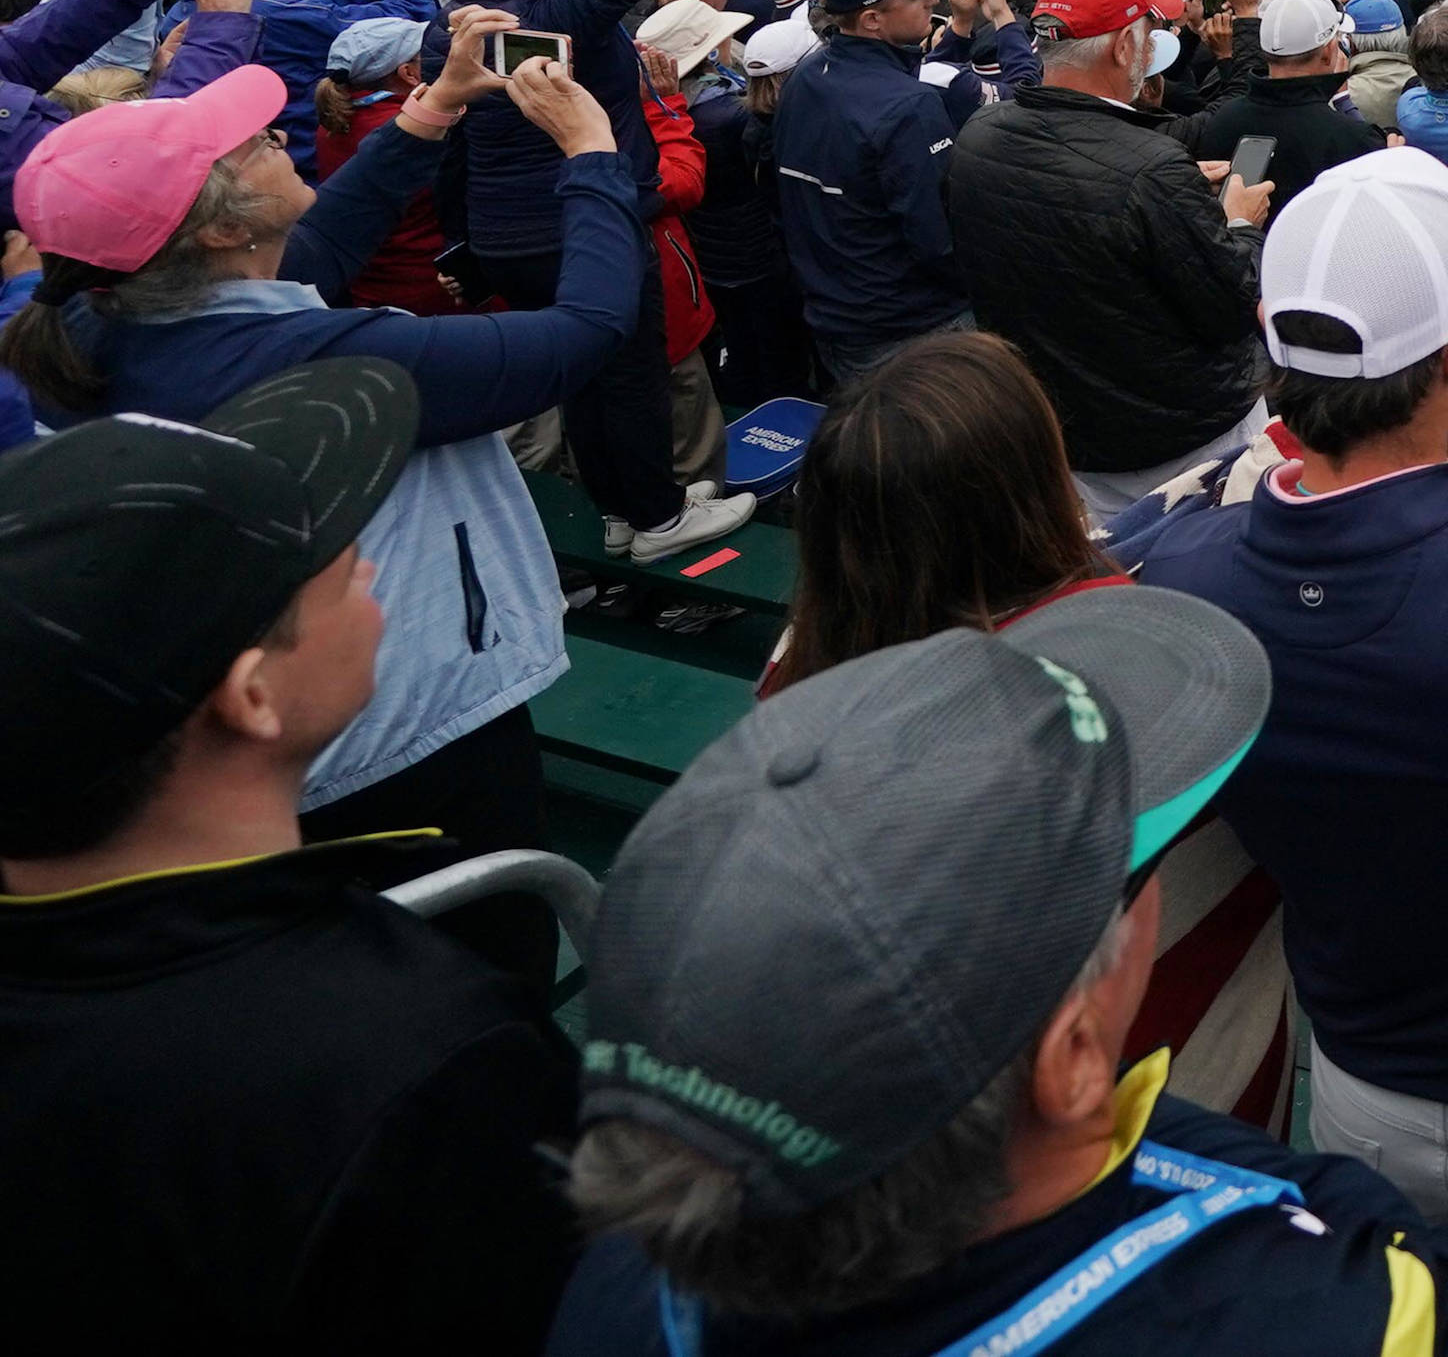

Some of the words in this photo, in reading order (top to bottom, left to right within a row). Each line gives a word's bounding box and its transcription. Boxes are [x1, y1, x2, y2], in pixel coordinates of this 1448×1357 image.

[929, 137, 953, 155] USGA
[741, 434, 794, 452] EXPRESS
[745, 426, 805, 447] AMERICAN
[622, 1042, 842, 1167] Technology
